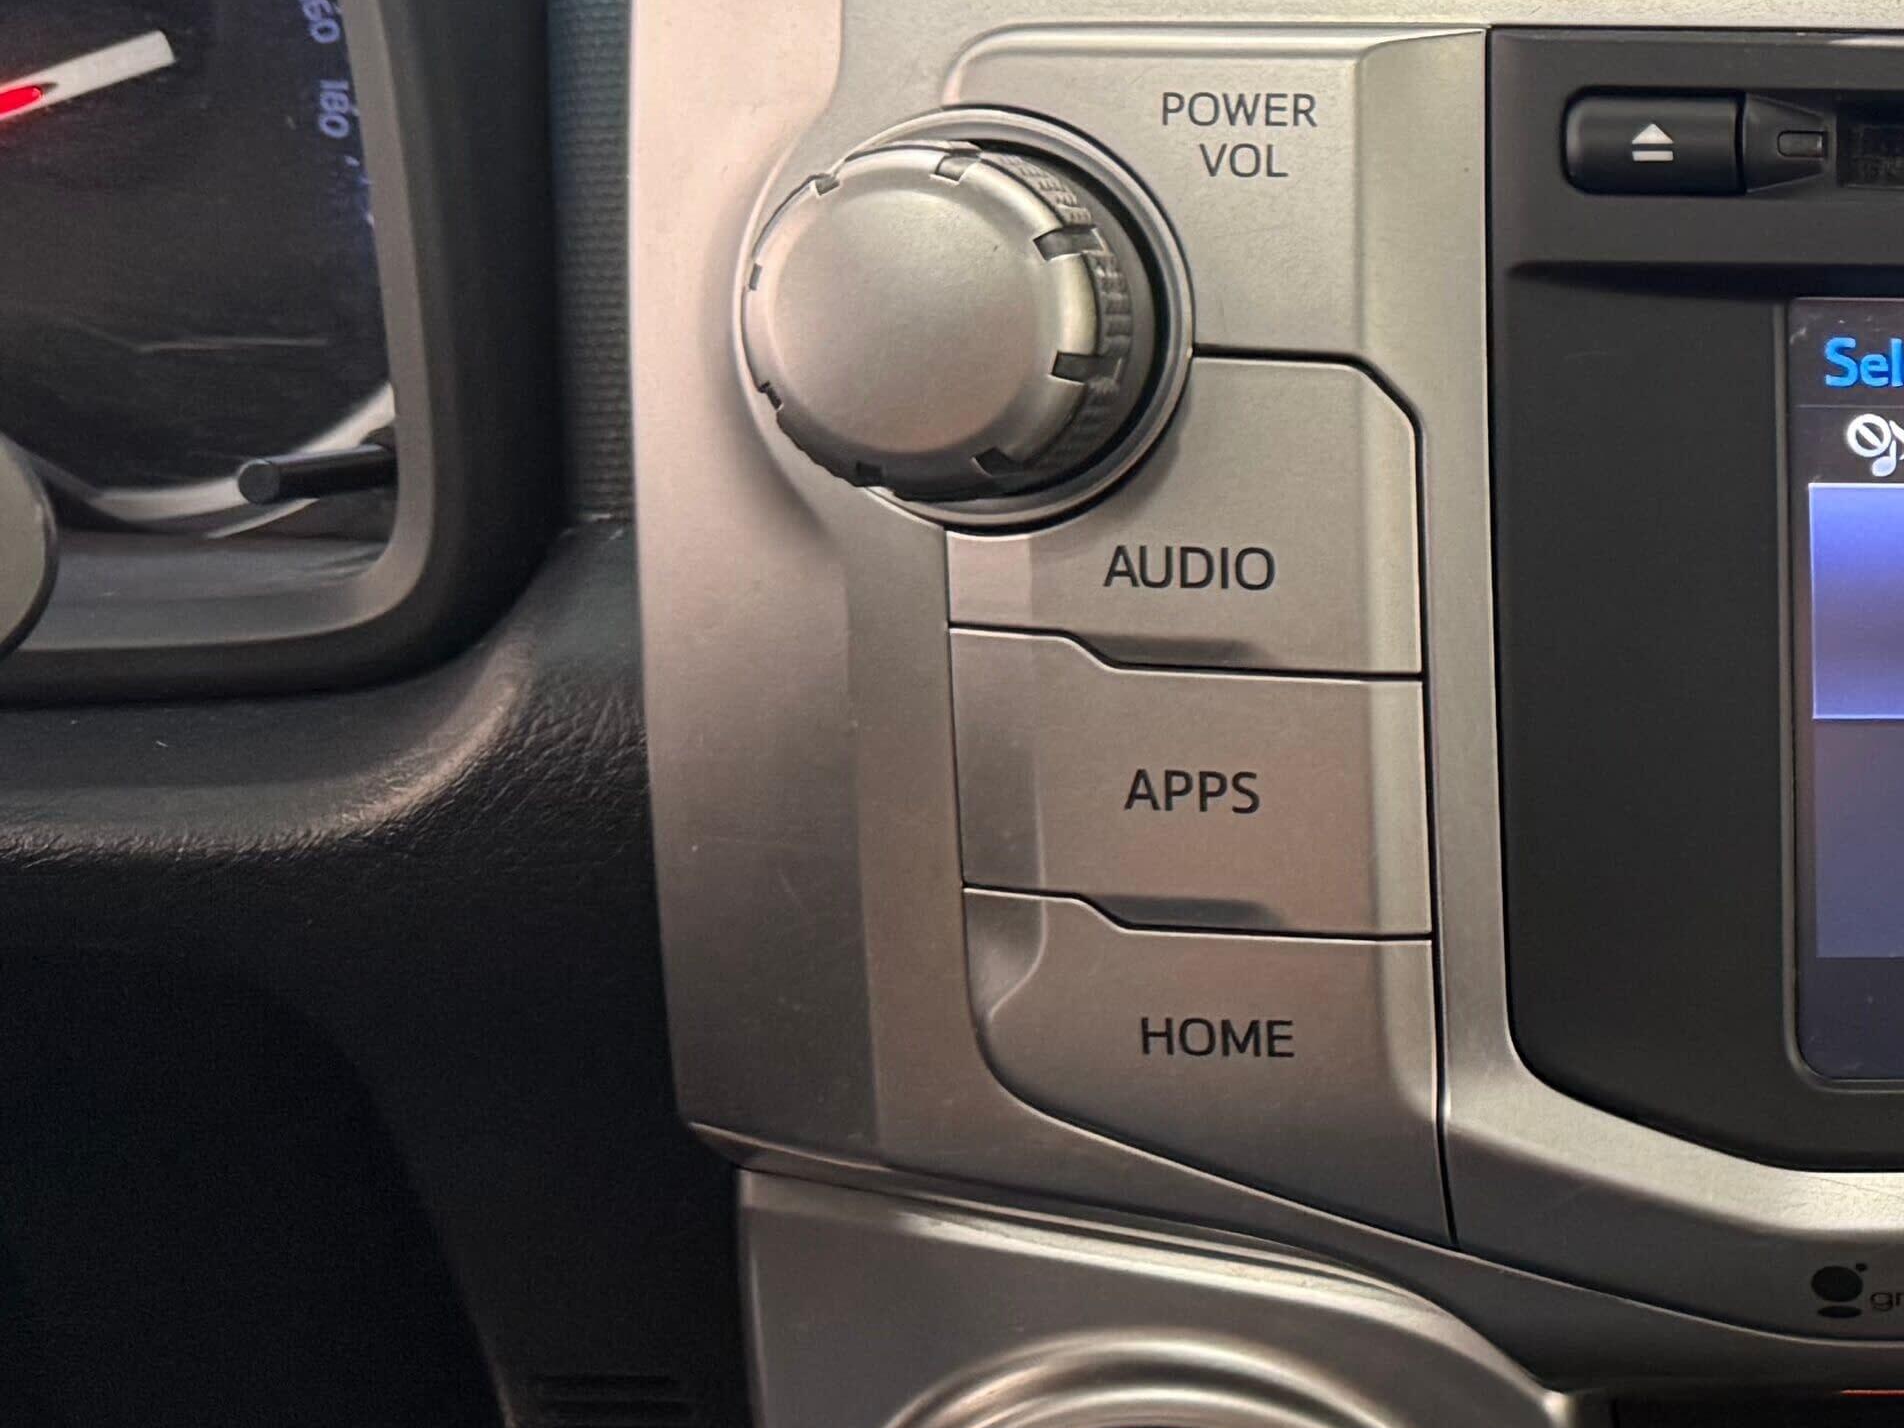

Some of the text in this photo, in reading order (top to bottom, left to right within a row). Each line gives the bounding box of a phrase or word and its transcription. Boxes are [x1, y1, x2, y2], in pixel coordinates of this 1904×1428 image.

[317, 78, 351, 139] 180
[1160, 91, 1319, 129] POWER
[1198, 142, 1290, 179] VOL
[1103, 544, 1276, 591] AUDIO
[1124, 768, 1261, 816] APPS
[1140, 1017, 1296, 1060] HOME
